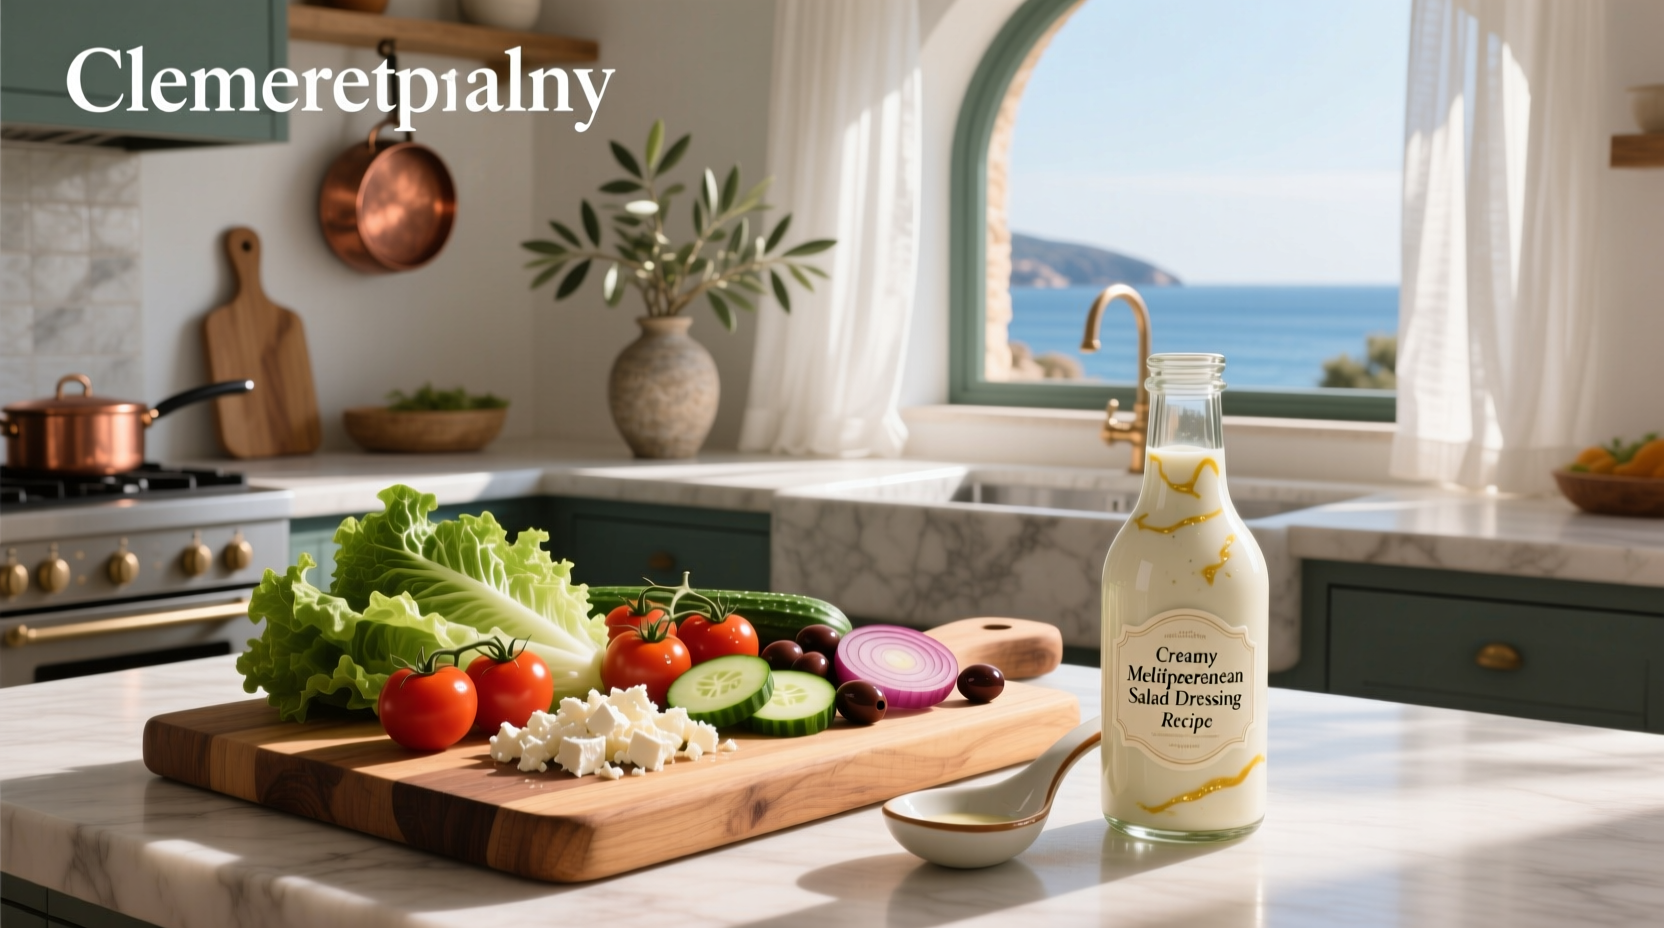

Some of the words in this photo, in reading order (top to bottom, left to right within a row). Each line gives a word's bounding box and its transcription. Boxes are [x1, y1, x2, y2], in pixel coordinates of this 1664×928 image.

[1156, 646, 1217, 668] Creamy
[1128, 687, 1169, 705] Salad
[1175, 690, 1242, 710] Dressing
